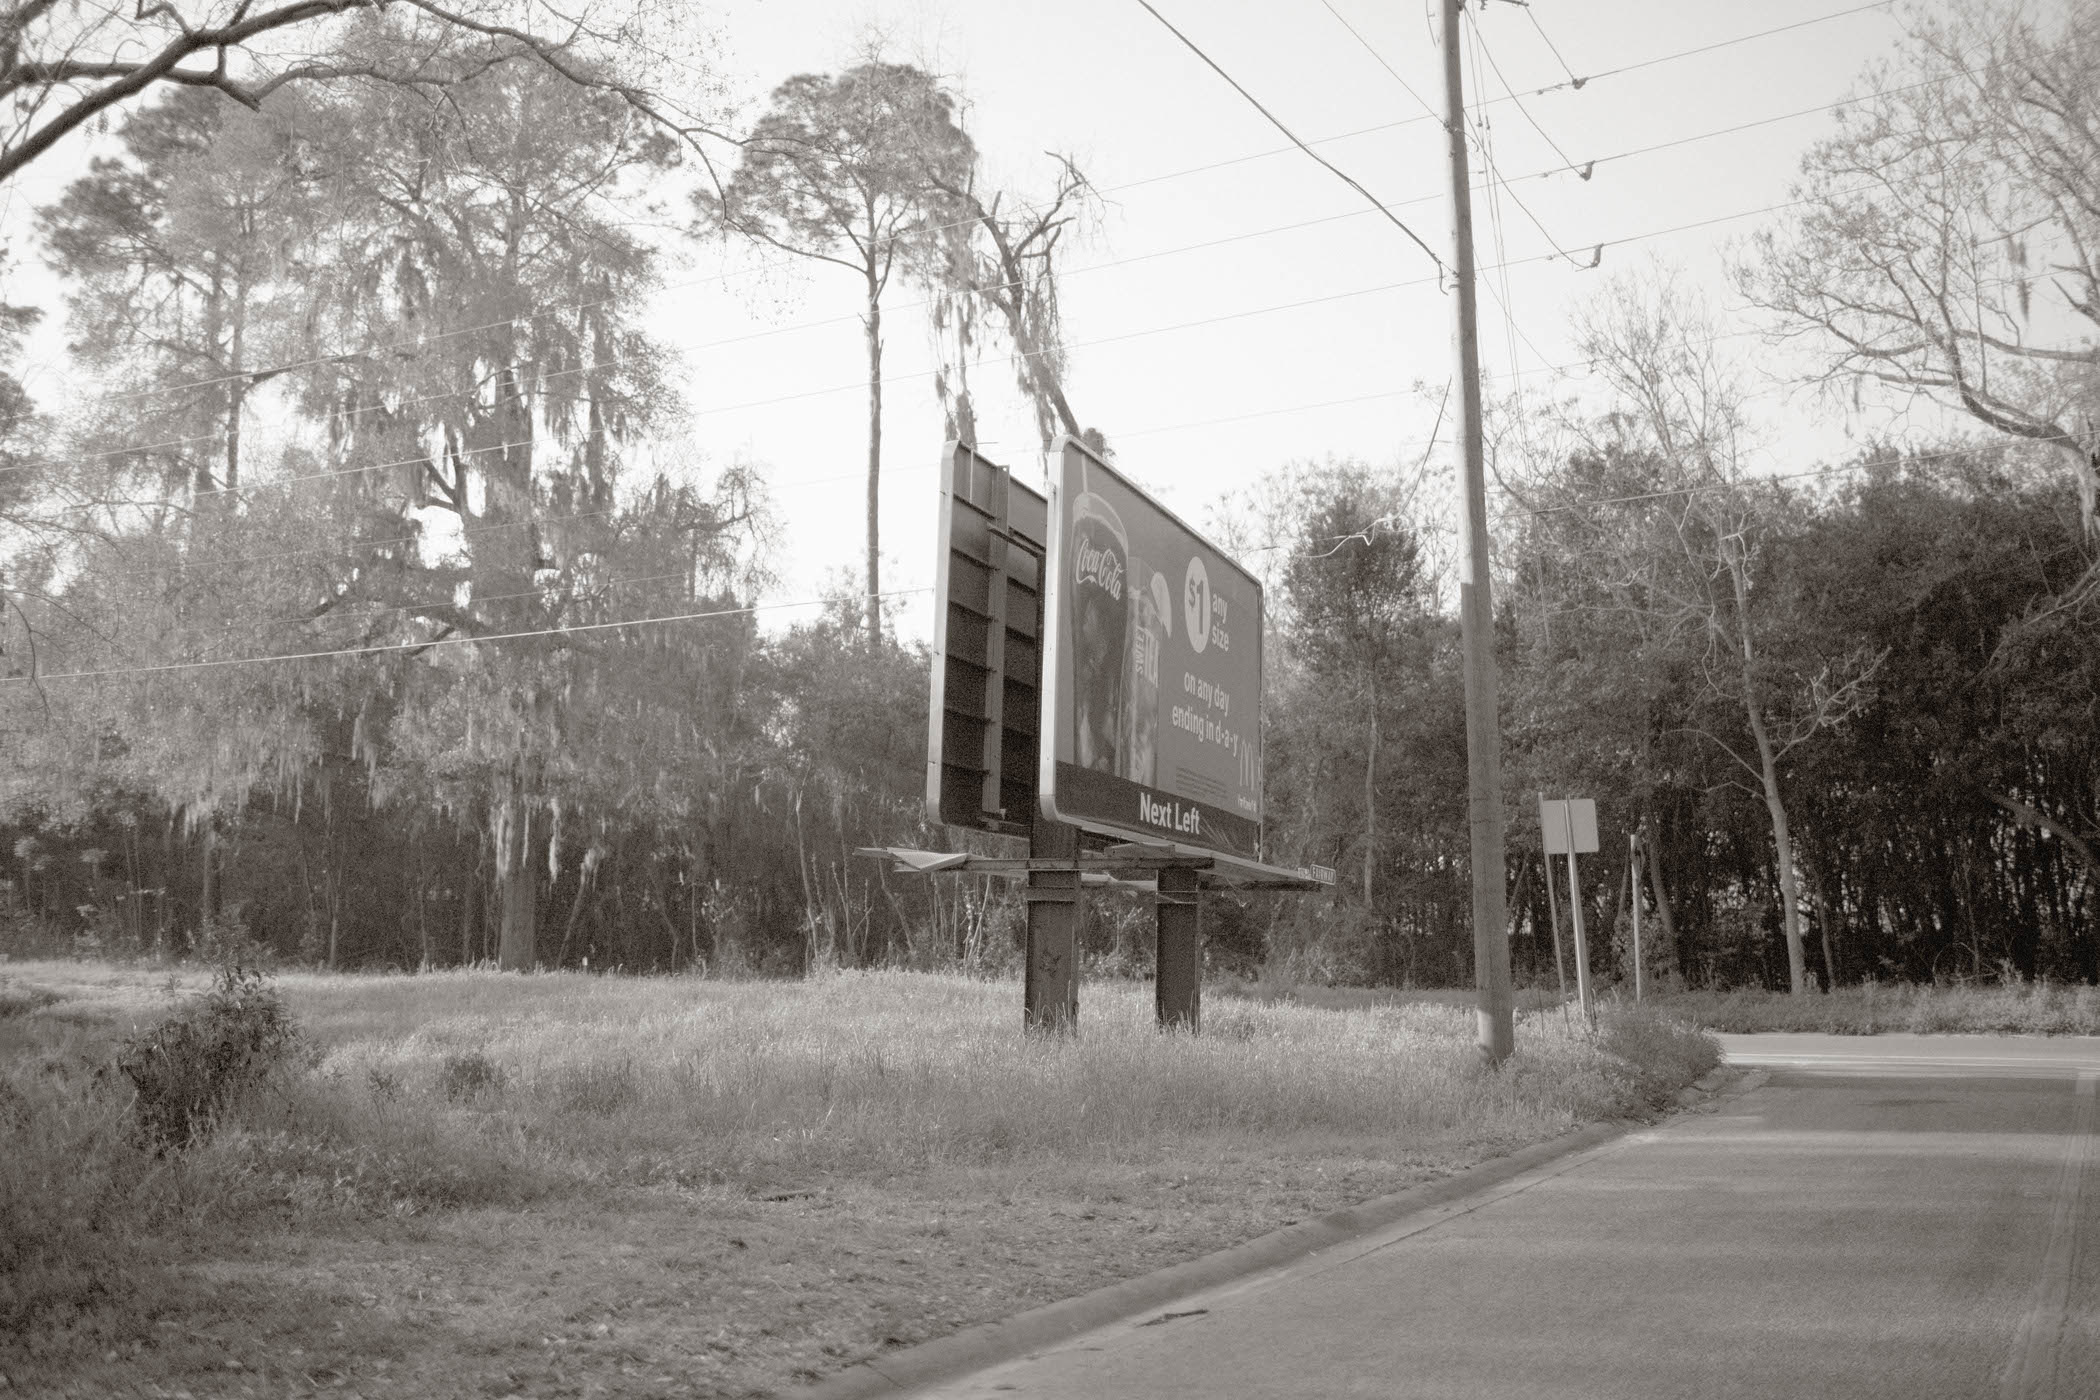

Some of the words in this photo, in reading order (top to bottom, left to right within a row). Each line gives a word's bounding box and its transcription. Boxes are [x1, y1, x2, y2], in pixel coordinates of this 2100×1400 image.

[1076, 538, 1125, 601] Coca-Cola
[1188, 577, 1204, 635] $1
[1212, 593, 1228, 623] any
[1135, 625, 1145, 675] SWEET
[1211, 622, 1229, 652] size
[1183, 671, 1196, 695] on
[1197, 679, 1213, 709] any
[1214, 683, 1229, 717] day
[1172, 705, 1204, 743] ending
[1206, 714, 1214, 741] in
[1140, 791, 1172, 829] Next
[1175, 802, 1200, 835] Left
